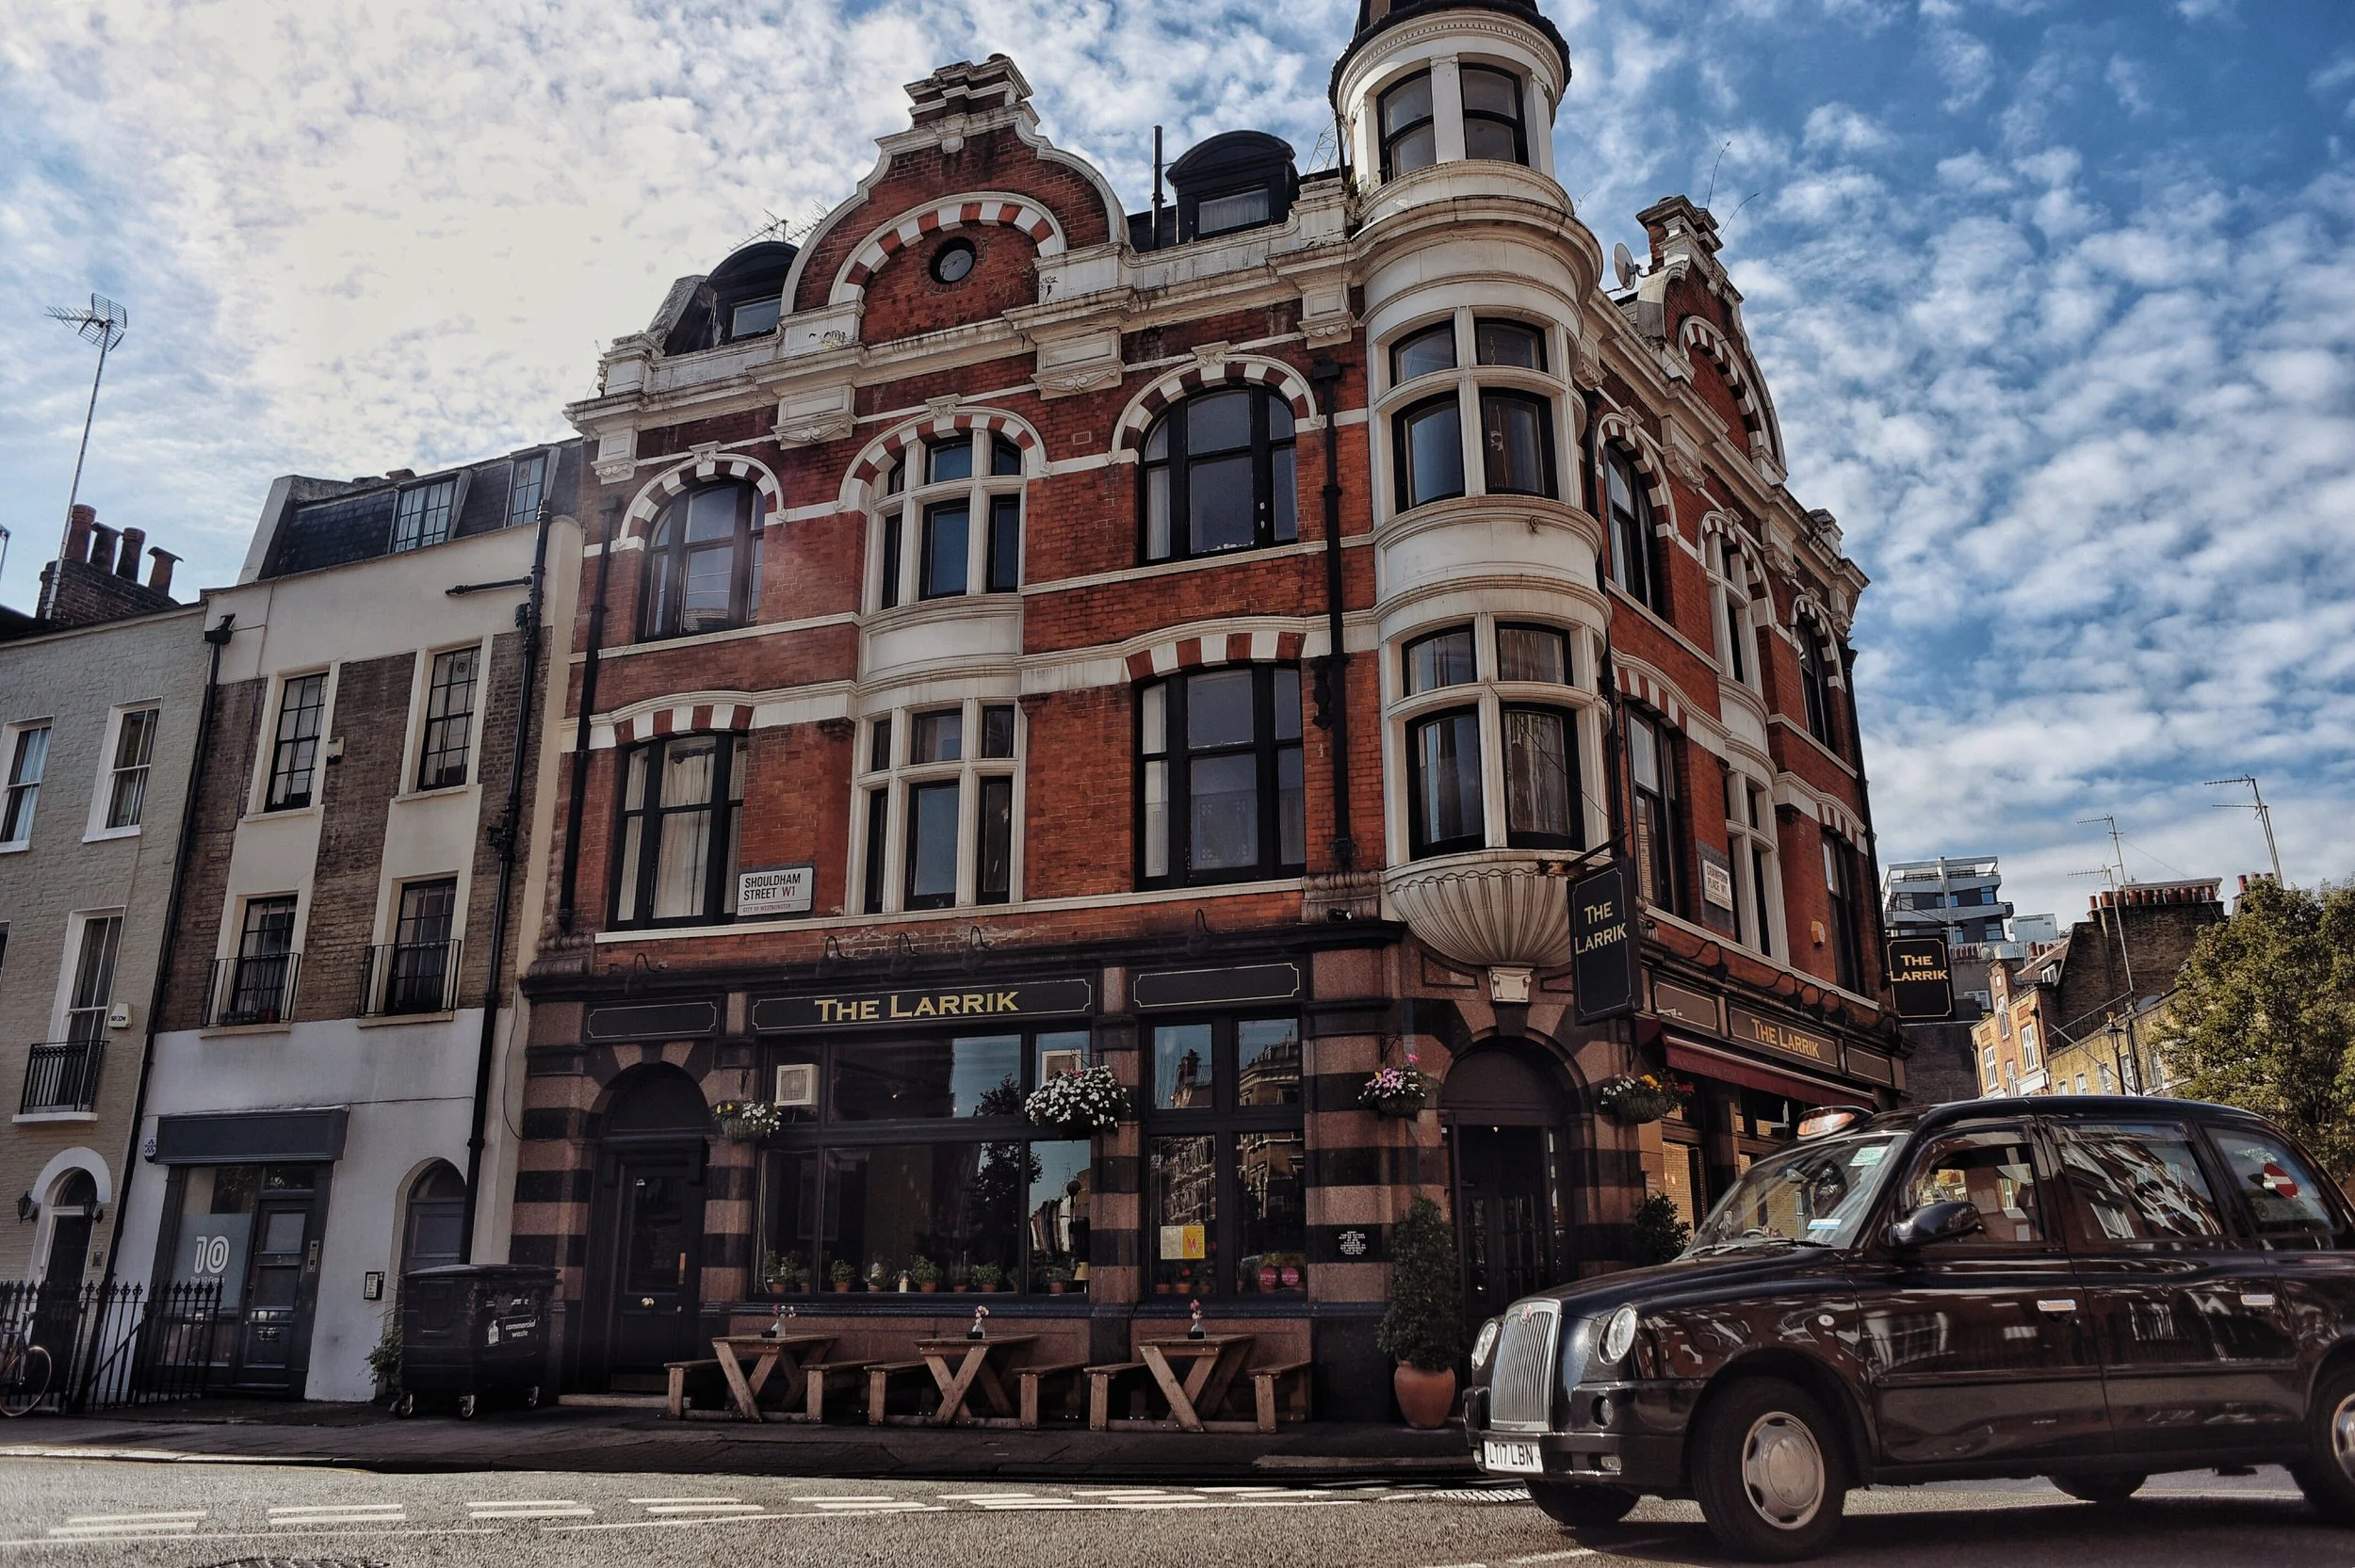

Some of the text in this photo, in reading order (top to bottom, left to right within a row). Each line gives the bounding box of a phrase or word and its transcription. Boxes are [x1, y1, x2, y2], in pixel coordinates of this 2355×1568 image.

[744, 873, 801, 888] SHOULDHAM
[1707, 877, 1720, 892] PLACE
[743, 885, 796, 900] STREET W1
[742, 904, 753, 913] CITY
[1584, 900, 1614, 925] THE
[1574, 922, 1628, 955] LARRIK
[1900, 954, 1934, 966] THE
[1890, 969, 1949, 982] LARRIK
[814, 992, 1020, 1022] THE LARRIK
[1751, 1018, 1821, 1059] THE LARRIK
[194, 1236, 230, 1274] 10
[505, 1318, 536, 1330] commercial
[512, 1330, 528, 1338] waste
[1510, 1443, 1535, 1467] LBN
